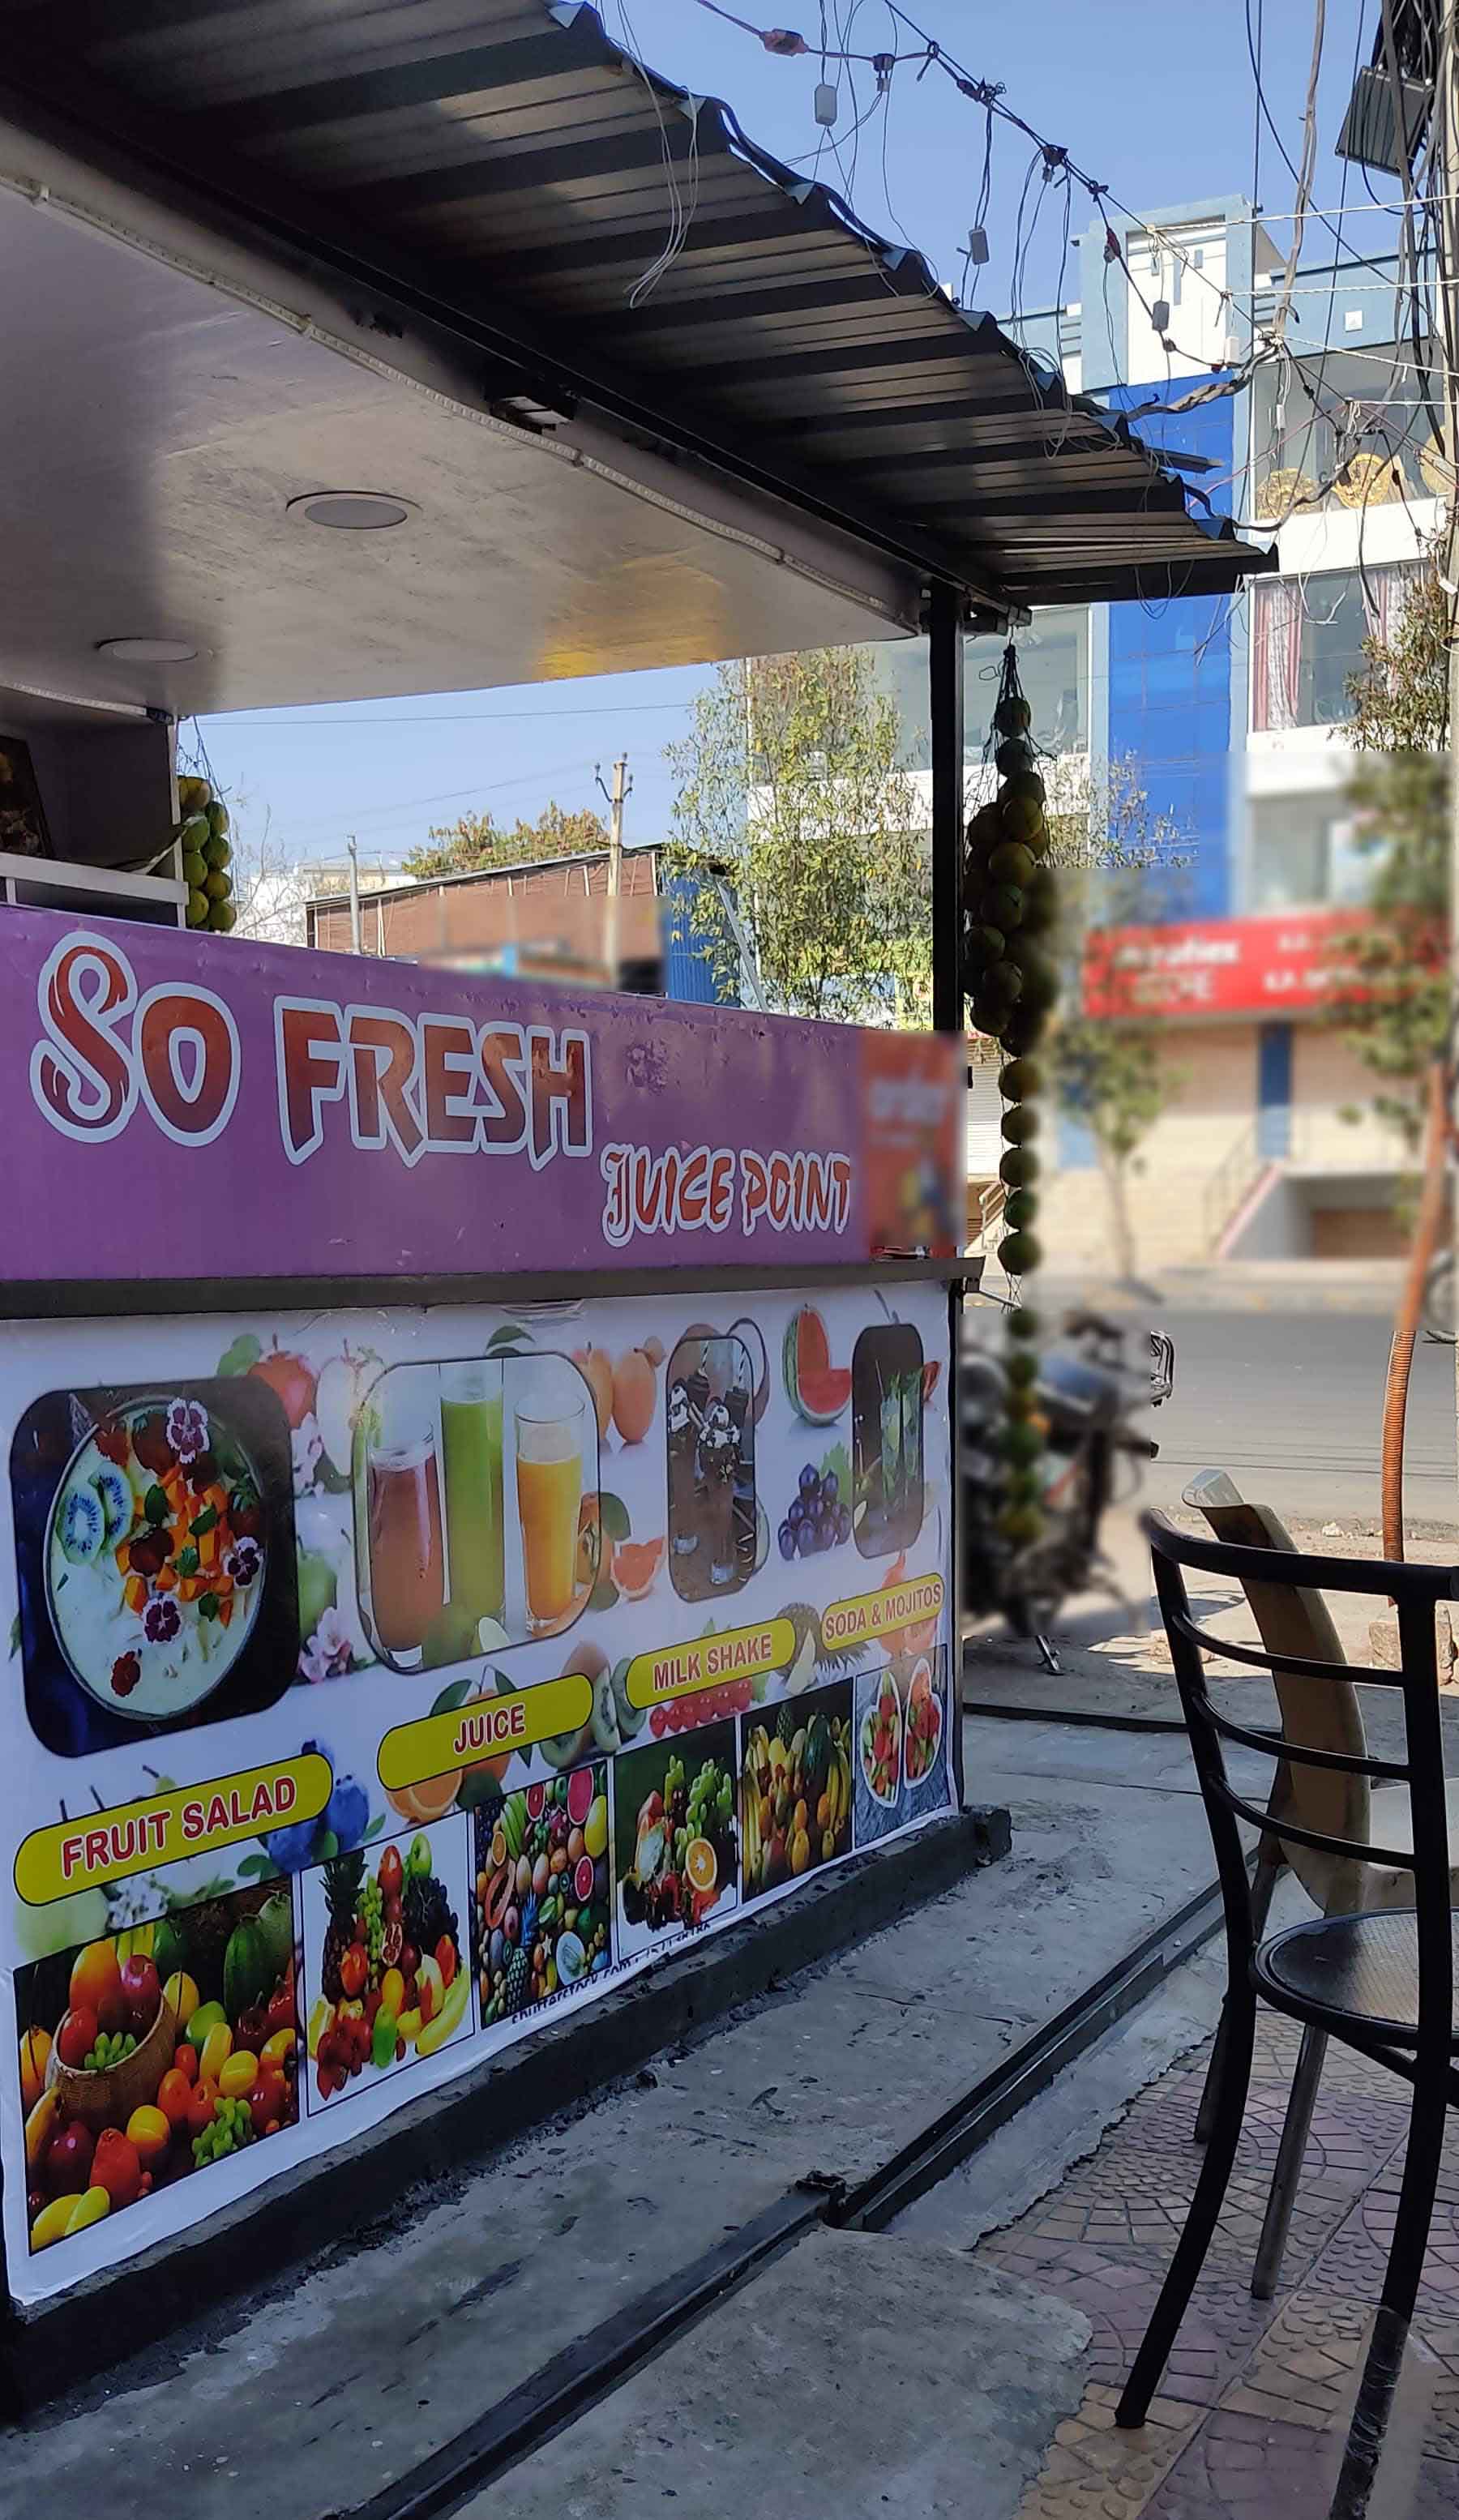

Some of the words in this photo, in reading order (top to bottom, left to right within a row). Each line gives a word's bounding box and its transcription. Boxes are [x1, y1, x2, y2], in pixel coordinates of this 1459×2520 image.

[30, 931, 240, 1146] SO
[274, 995, 592, 1170] FRESH
[601, 1142, 735, 1247] JUICE
[740, 1149, 850, 1236] POINT
[824, 1607, 867, 1641] SODA
[871, 1602, 882, 1628] &
[885, 1581, 943, 1622] MOJITOS
[653, 1653, 702, 1692] MILK
[706, 1632, 772, 1676] SHAKE
[454, 1702, 525, 1755] JUICE
[61, 1809, 172, 1879] FRUIT
[182, 1777, 297, 1841] SALAD
